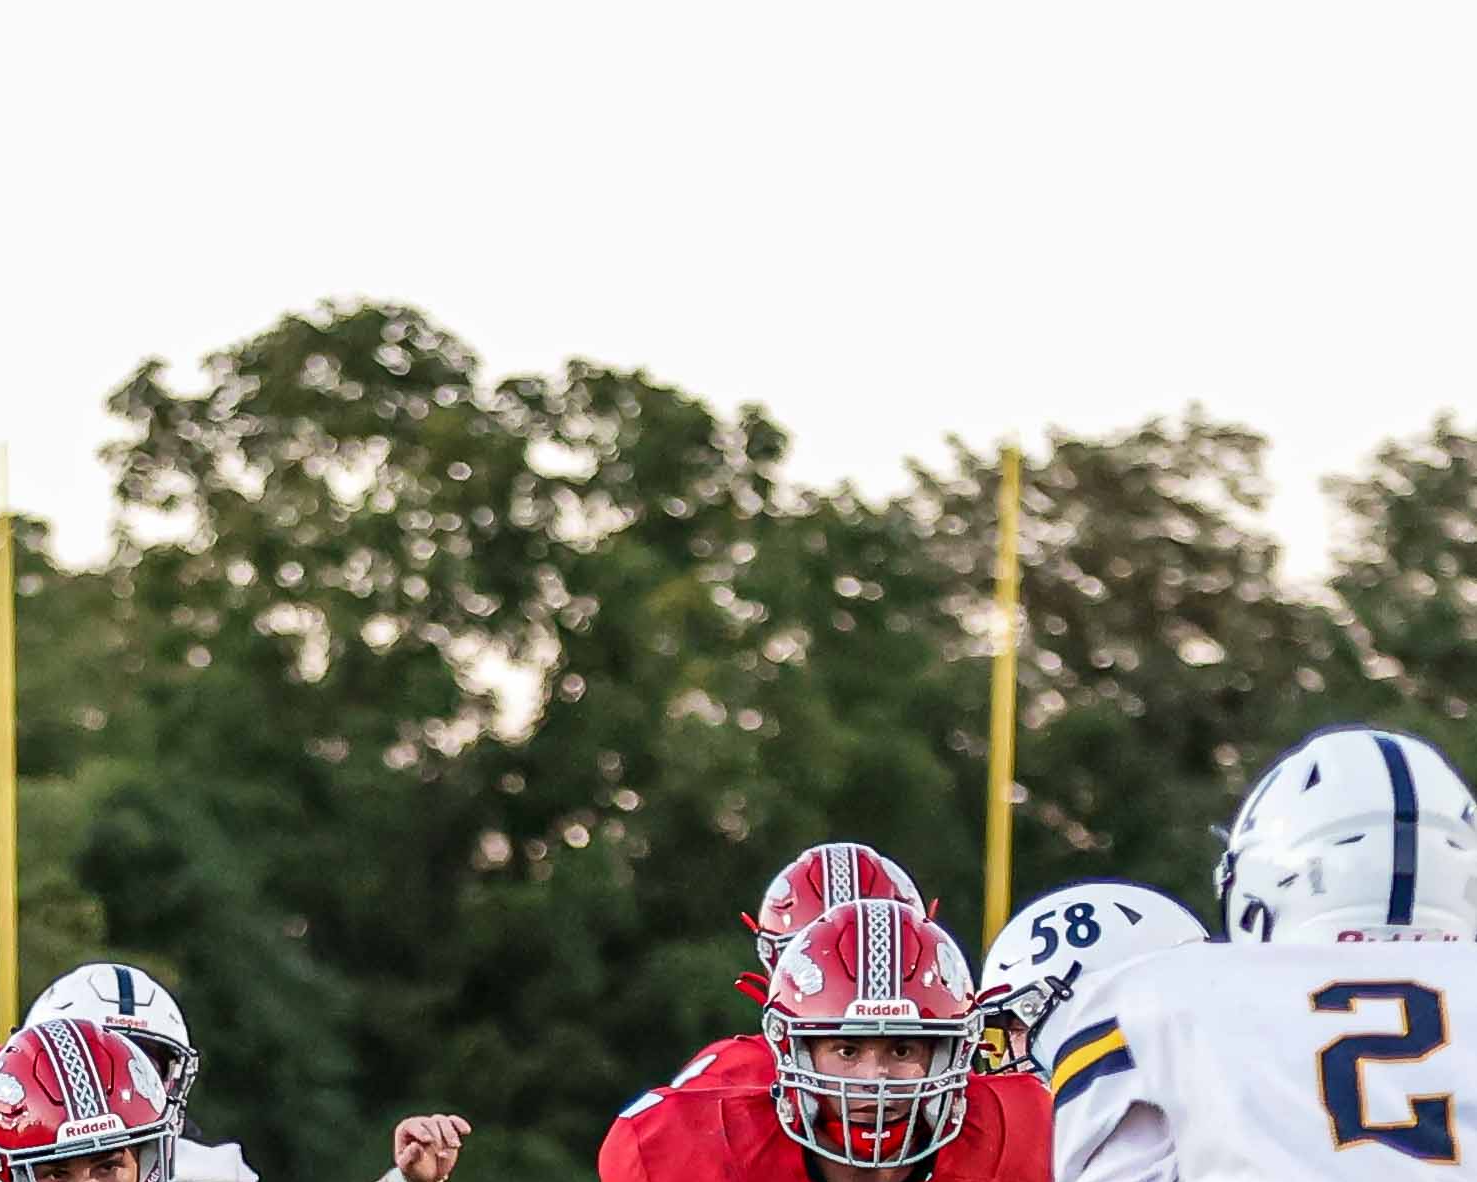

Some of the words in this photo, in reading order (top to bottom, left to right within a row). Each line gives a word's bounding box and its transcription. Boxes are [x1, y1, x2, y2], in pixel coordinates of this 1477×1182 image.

[1031, 903, 1101, 965] 58
[856, 1004, 910, 1016] Riddell
[1308, 980, 1461, 1165] 2
[66, 1119, 116, 1138] Riddell
